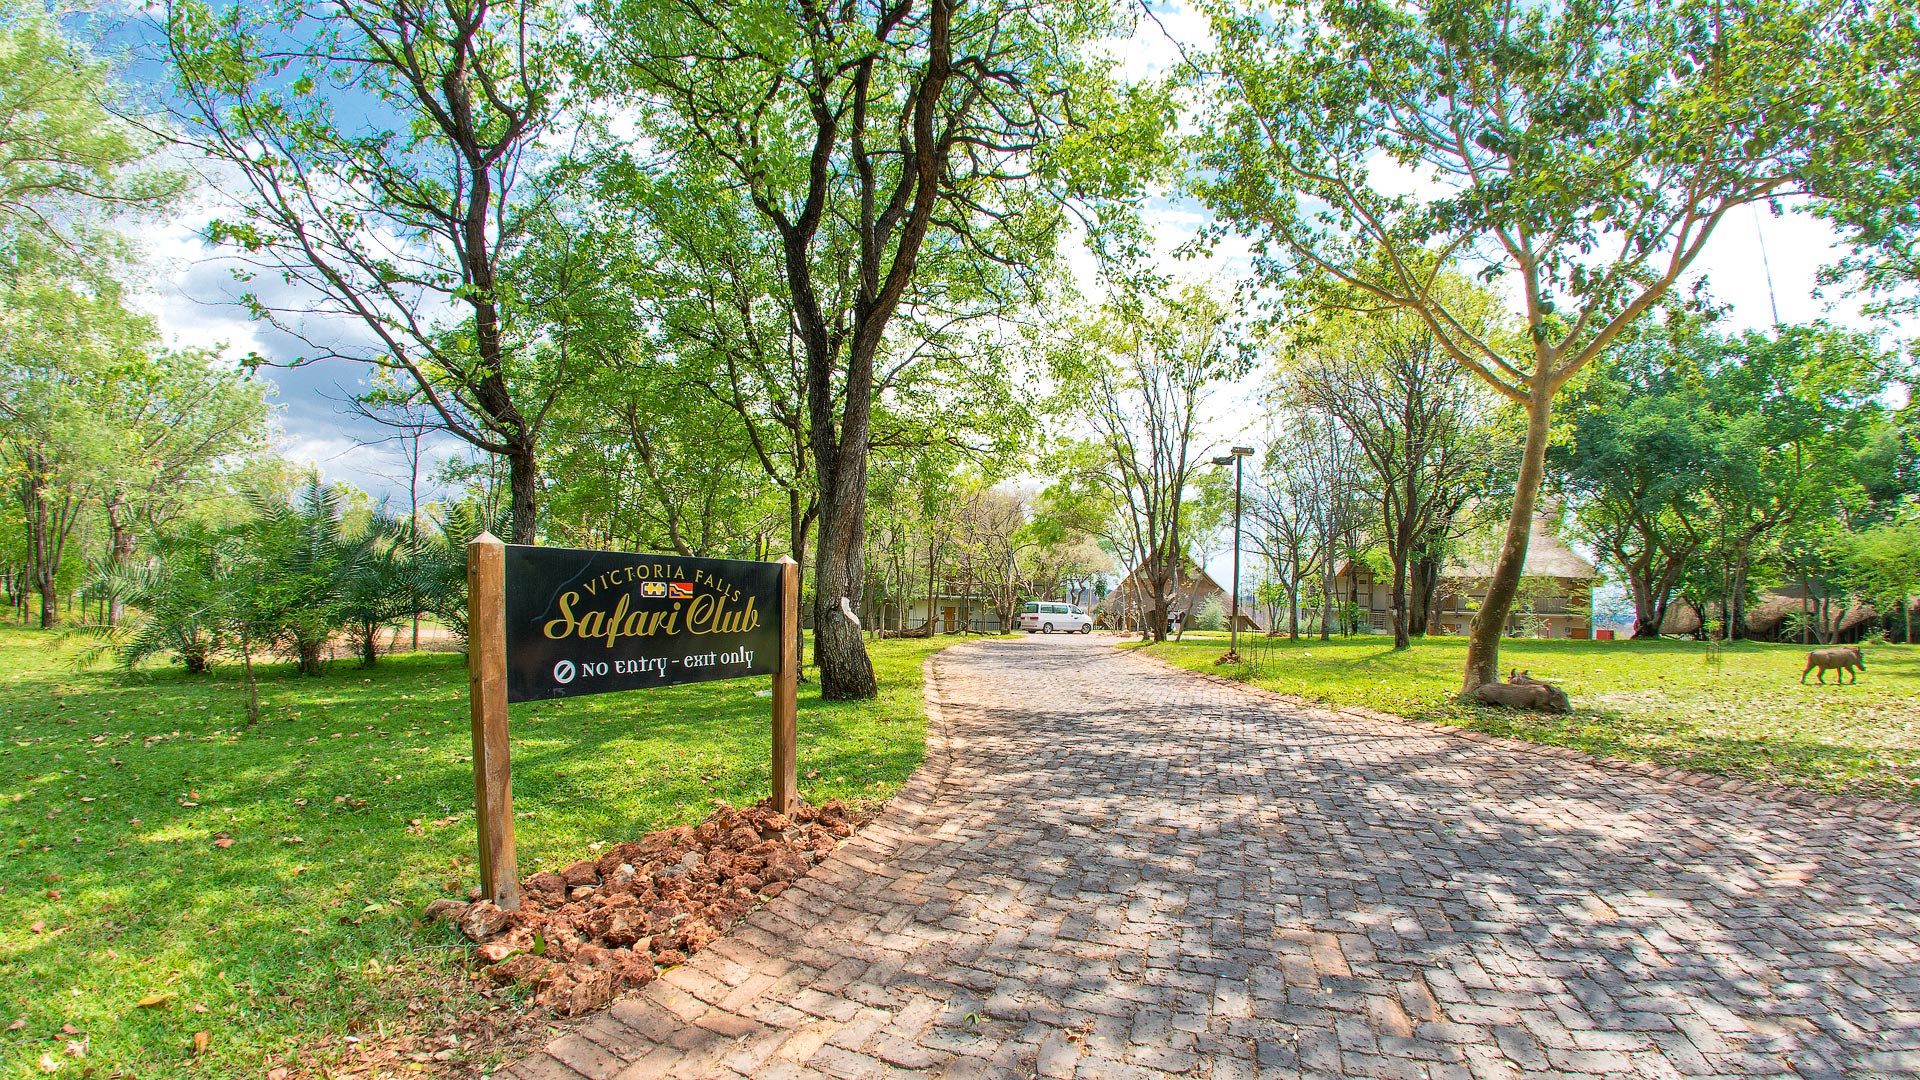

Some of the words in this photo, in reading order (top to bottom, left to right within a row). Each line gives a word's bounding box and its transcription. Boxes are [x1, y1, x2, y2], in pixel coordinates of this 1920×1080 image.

[583, 564, 685, 596] VICTORIA
[695, 569, 742, 602] FALLS
[543, 591, 681, 648] Safari
[686, 593, 761, 635] Club
[582, 662, 609, 677] NO
[683, 651, 717, 668] exit
[720, 646, 754, 668] only
